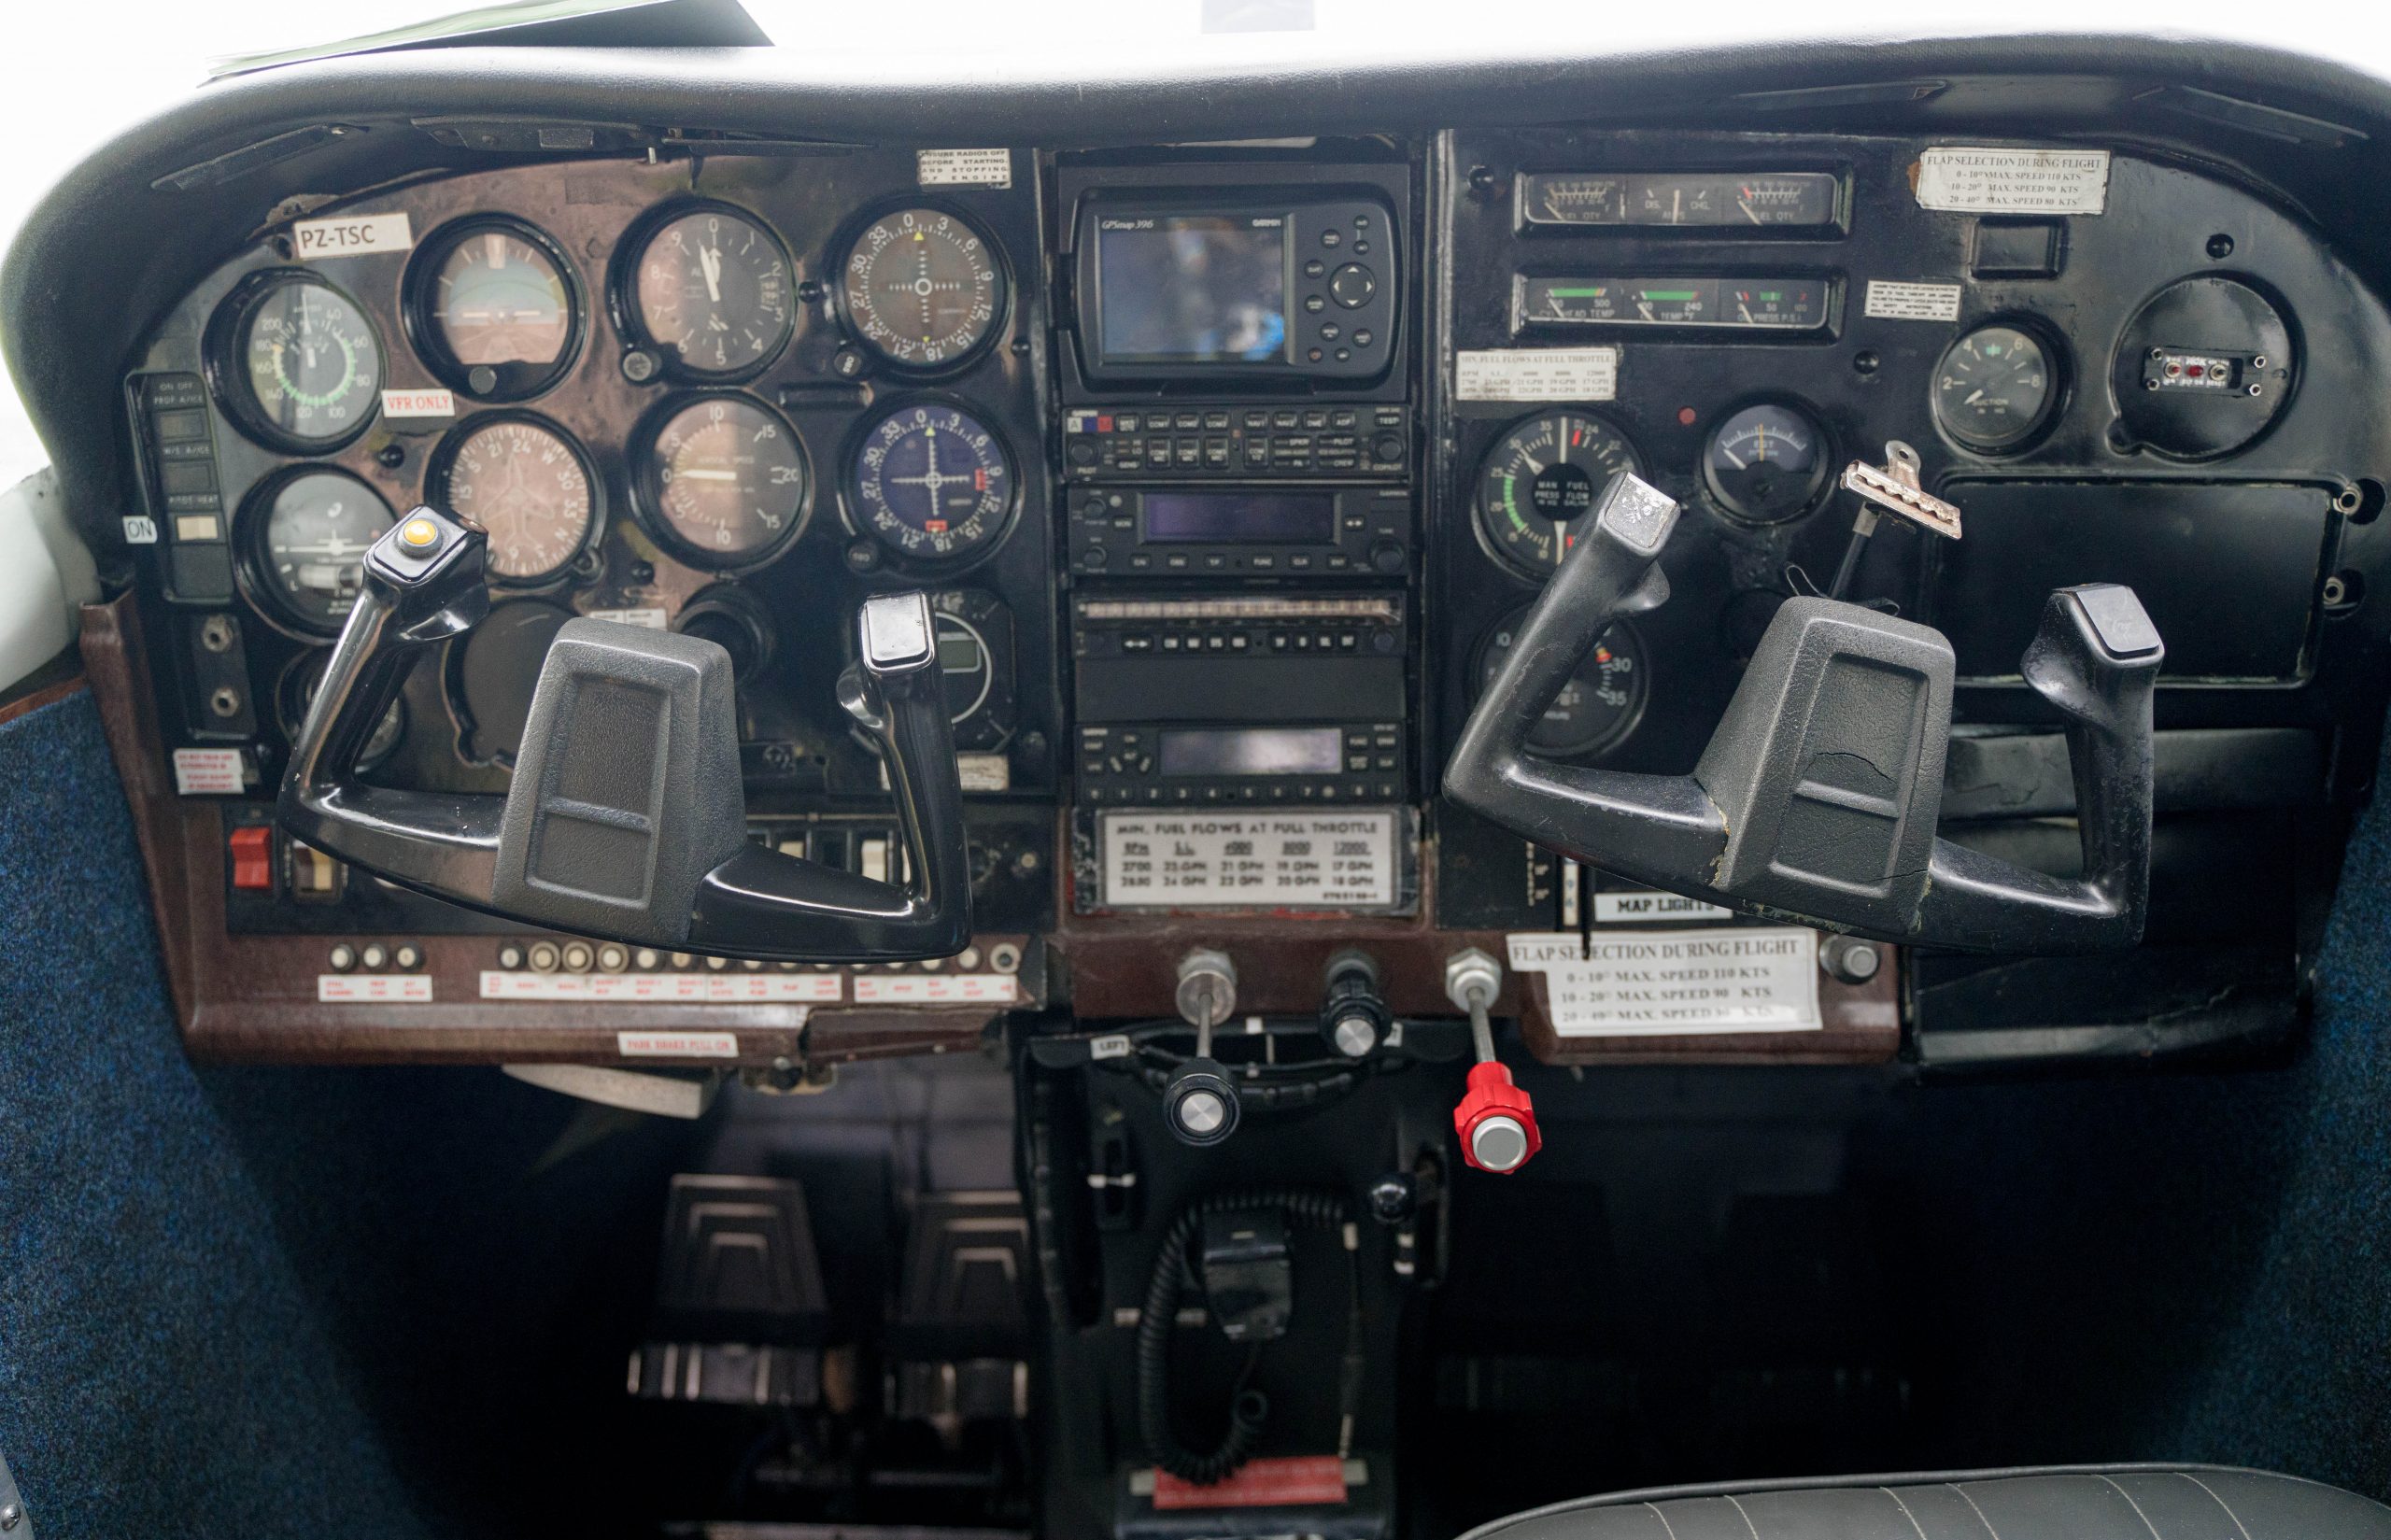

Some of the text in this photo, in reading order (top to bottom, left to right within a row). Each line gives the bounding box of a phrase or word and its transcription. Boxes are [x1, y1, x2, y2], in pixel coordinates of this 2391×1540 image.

[1927, 156, 2101, 169] FLAP SELECTION DURING FLIGHT
[2062, 173, 2081, 181] KTS
[1949, 195, 1959, 204] 20
[2012, 197, 2043, 205] SPEED
[2059, 198, 2077, 206] KTS
[903, 213, 913, 227] 0
[1776, 212, 1795, 220] QTY
[708, 218, 719, 233] 0
[937, 217, 949, 231] 3
[1136, 219, 1154, 229] 396
[301, 224, 376, 250] PZ-TSC
[671, 231, 682, 247] 9
[749, 231, 755, 246] 1
[868, 225, 887, 245] 33
[965, 237, 979, 251] 6
[650, 264, 660, 279] 8
[771, 261, 782, 276] 2
[851, 253, 868, 275] 30
[981, 271, 995, 281] 9
[848, 290, 865, 309] 27
[1593, 298, 1611, 308] 500
[654, 305, 663, 320] 7
[774, 307, 785, 322] 3
[978, 303, 993, 321] 12
[1590, 309, 1615, 318] TEMP
[1661, 312, 1683, 321] TEMP
[864, 321, 883, 340] 24
[677, 338, 688, 353] 6
[751, 338, 763, 352] 4
[956, 332, 975, 349] 15
[1963, 338, 1973, 352] 4
[2014, 337, 2024, 351] 6
[715, 350, 727, 365] 5
[893, 345, 912, 360] 21
[925, 346, 944, 361] 18
[1943, 375, 1953, 390] 2
[2030, 374, 2041, 388] 8
[387, 395, 450, 411] VFR ONLY
[710, 405, 724, 420] 10
[915, 409, 927, 423] 0
[951, 414, 960, 428] 3
[762, 424, 777, 437] 15
[881, 420, 900, 440] 33
[513, 438, 531, 453] 24
[671, 432, 681, 447] 5
[976, 433, 989, 447] 6
[487, 440, 503, 459] 21
[863, 446, 880, 466] 30
[661, 469, 672, 484] 0
[782, 468, 799, 482] 20
[989, 466, 1004, 477] 9
[861, 481, 877, 499] 27
[676, 504, 686, 519] 5
[985, 495, 1002, 513] 12
[766, 515, 781, 530] 15
[874, 512, 893, 530] 24
[127, 521, 152, 539] ON
[716, 530, 731, 544] 10
[965, 523, 983, 540] 15
[901, 533, 921, 549] 21
[934, 537, 953, 552] 18
[1612, 657, 1633, 672] 30
[1606, 691, 1628, 706] 35
[1154, 824, 1186, 835] FUEL
[1192, 823, 1241, 835] FLOWS
[1250, 823, 1266, 834] AT
[1273, 823, 1305, 834] FULL
[1311, 822, 1377, 834] THROTTLE
[1123, 861, 1373, 872] 2700 GPH 17 GPH
[1238, 876, 1373, 886] GPH GPH
[1618, 899, 1652, 912] MAP
[1513, 940, 1798, 961] FLAP SEECTION DURING FLIGHT
[1566, 972, 1576, 983] 0
[1660, 968, 1709, 981] SPEED
[1714, 968, 1735, 979] 110
[1739, 967, 1770, 978] KTS
[1562, 993, 1577, 1003] 10
[1661, 988, 1710, 1000] SPEED
[1741, 987, 1773, 998] KTS
[1662, 1008, 1711, 1019] SPEED
